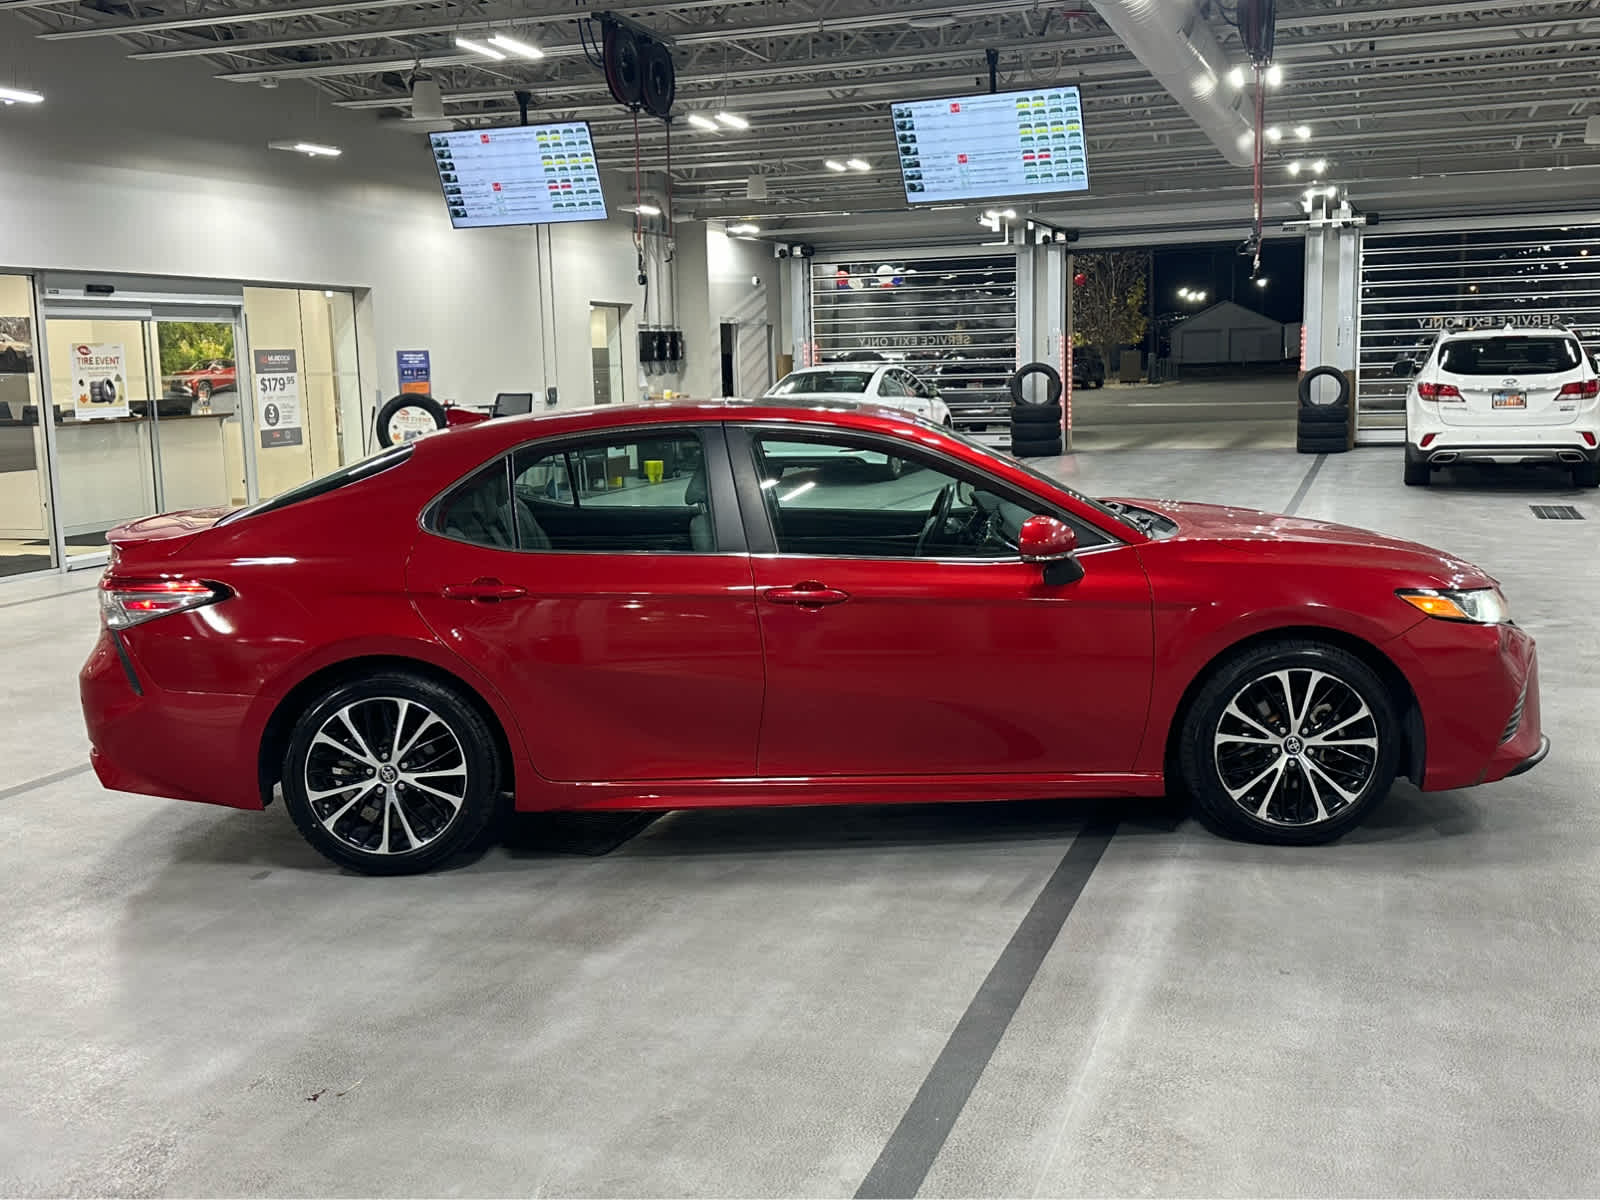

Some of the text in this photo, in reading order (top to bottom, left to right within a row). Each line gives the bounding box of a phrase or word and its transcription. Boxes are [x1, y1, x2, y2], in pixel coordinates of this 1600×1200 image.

[76, 357, 120, 365] TIRE EVENT
[268, 405, 275, 418] 3
